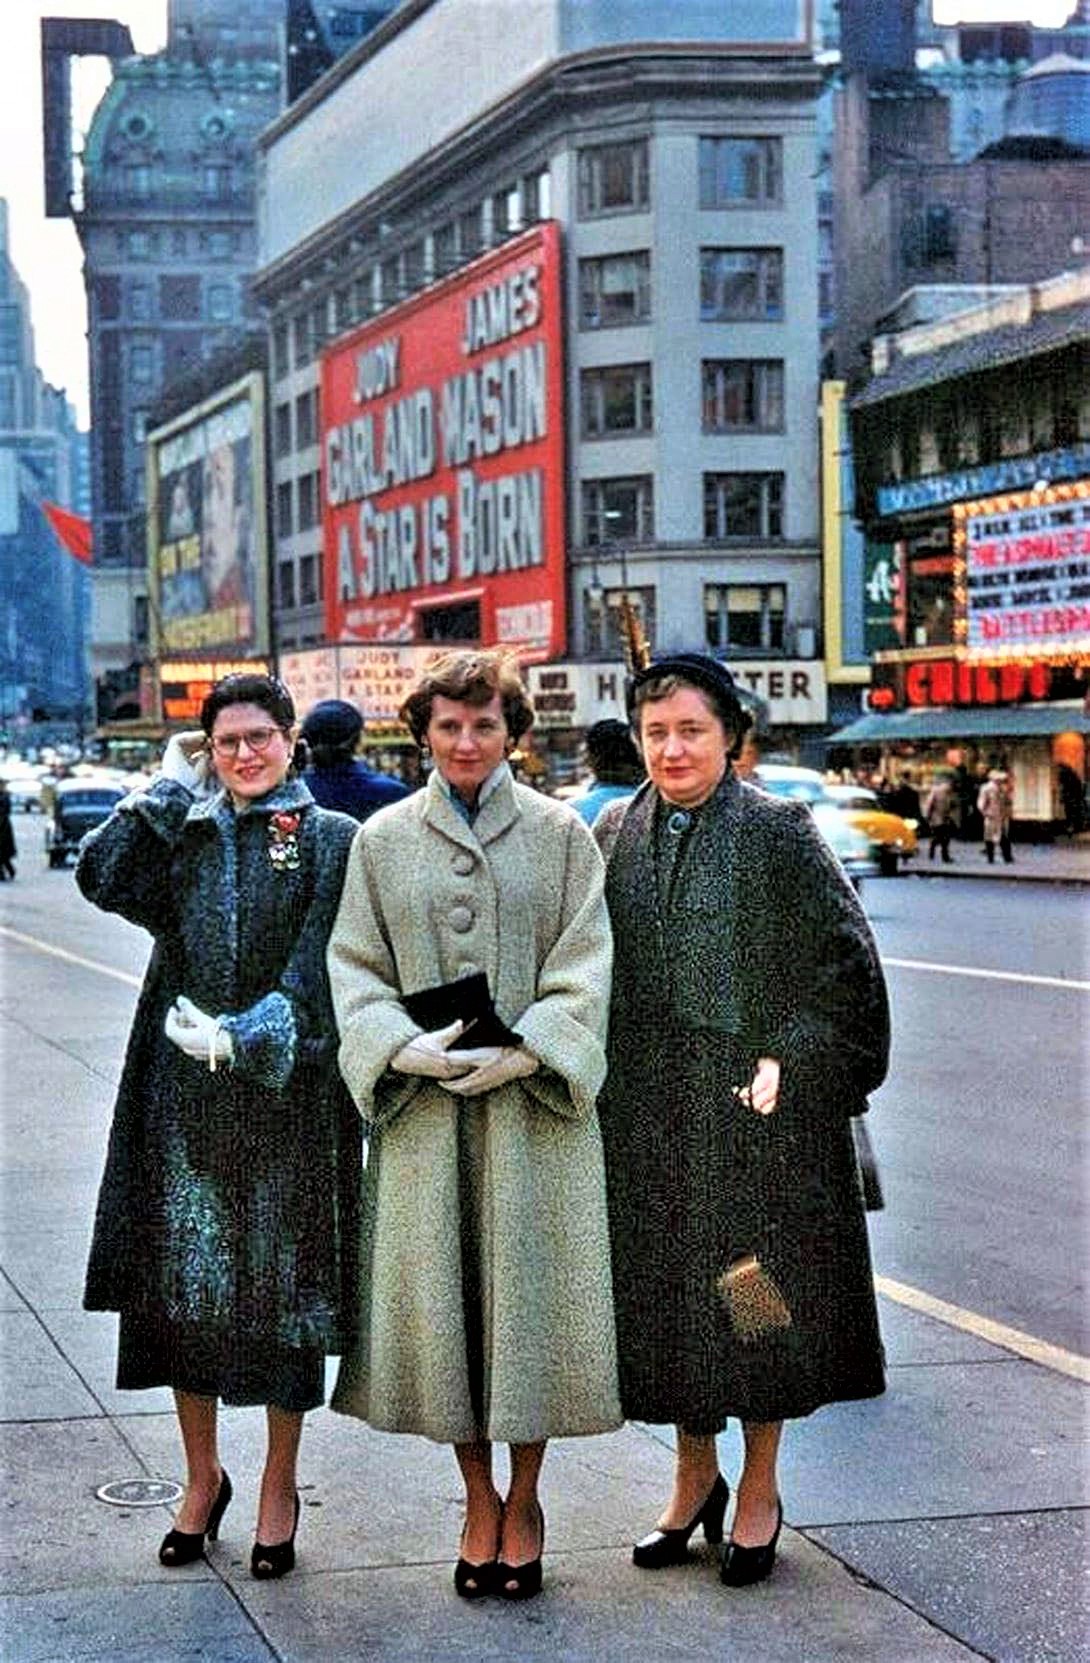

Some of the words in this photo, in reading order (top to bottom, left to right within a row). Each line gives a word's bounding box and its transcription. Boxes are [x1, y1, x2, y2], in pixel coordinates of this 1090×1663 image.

[462, 265, 541, 356] JAMES
[353, 335, 402, 404] JUDY
[326, 386, 435, 506] GARLAND
[441, 341, 546, 467] MASON
[338, 523, 357, 603] A
[359, 499, 418, 600] STAR
[424, 494, 449, 585] IS
[457, 467, 544, 581] BORN
[342, 667, 415, 680] GARLAND
[356, 650, 401, 665] JUDY
[733, 670, 812, 701] TER
